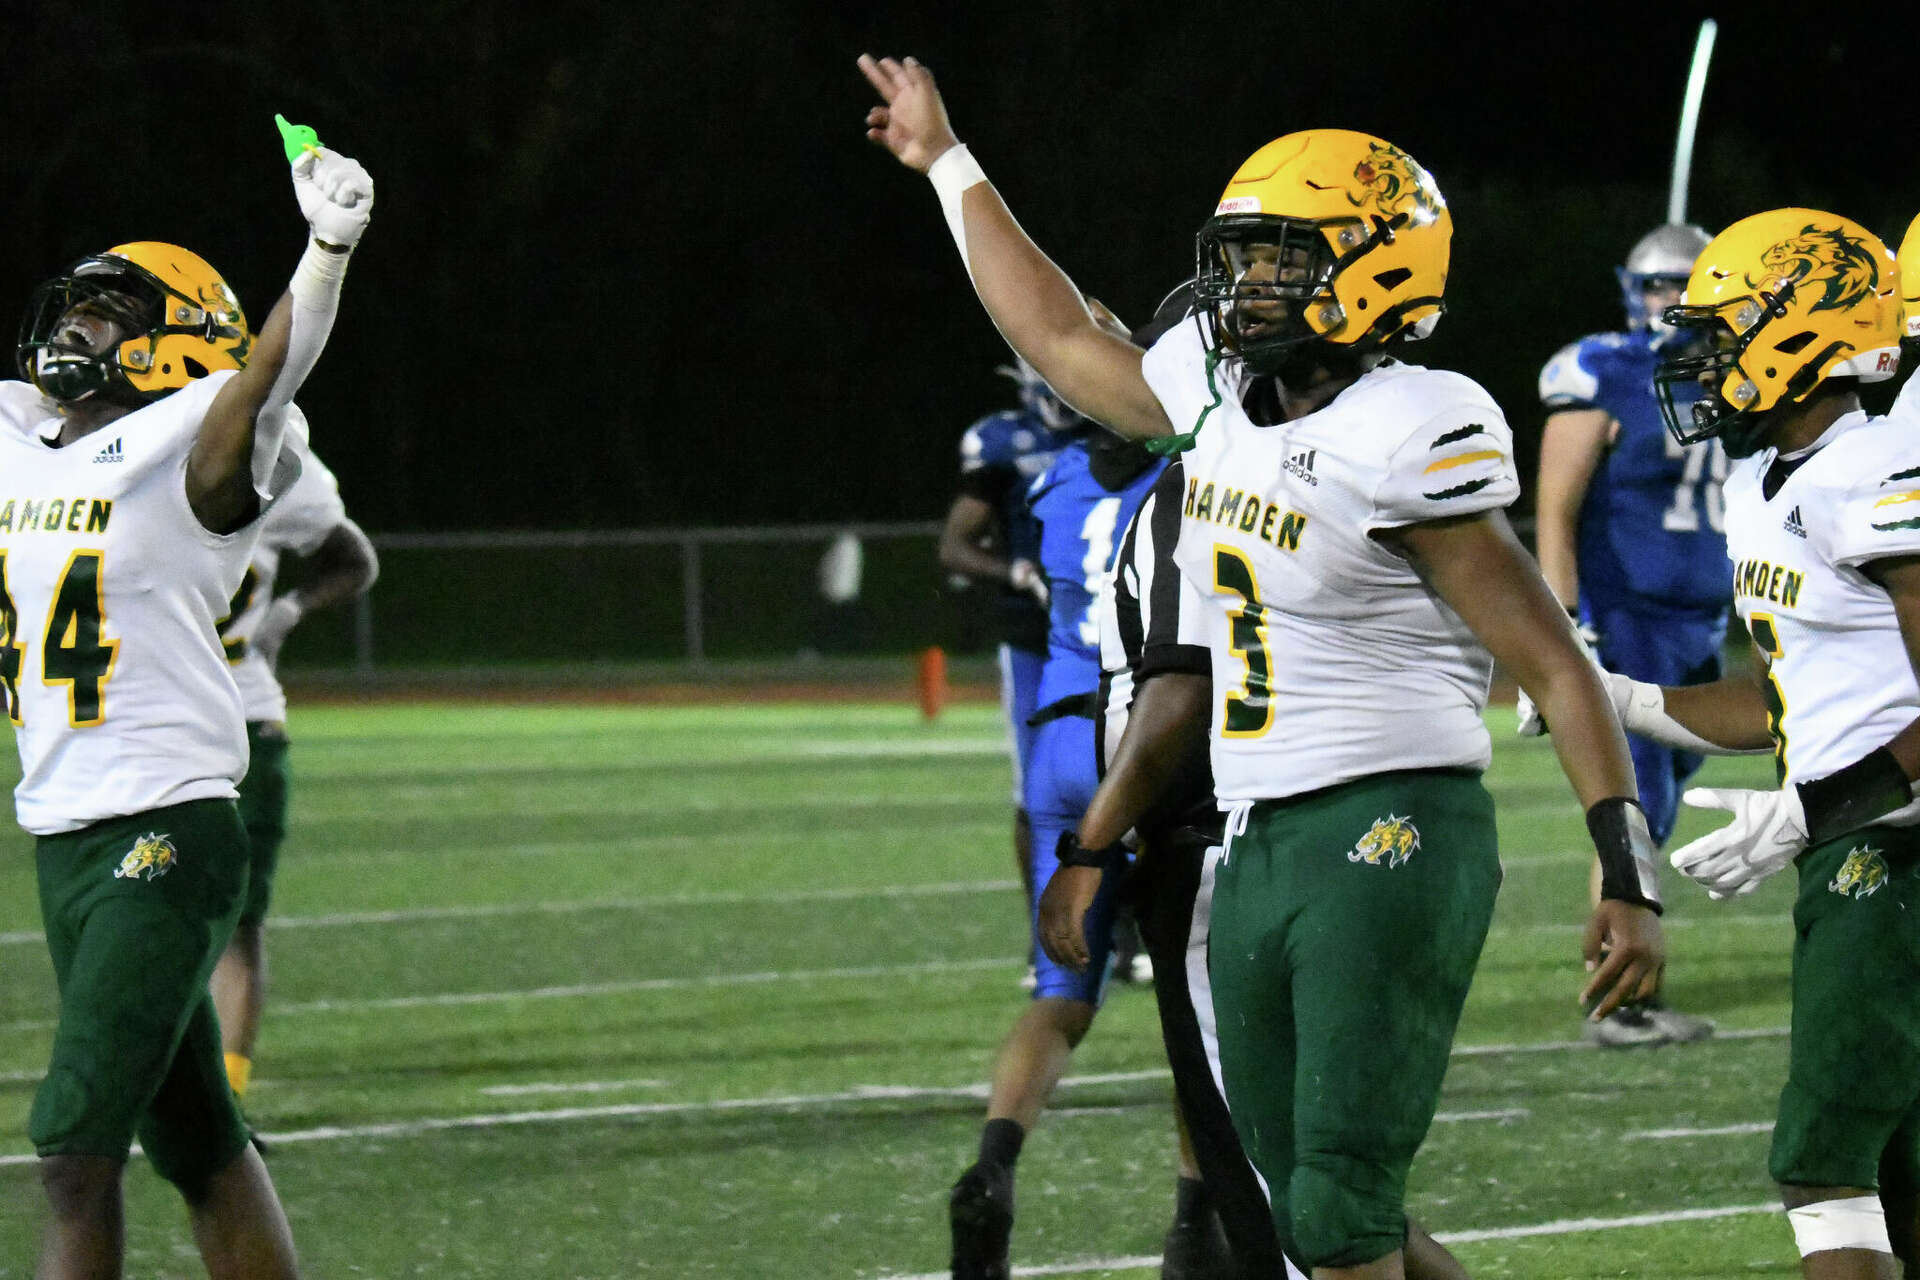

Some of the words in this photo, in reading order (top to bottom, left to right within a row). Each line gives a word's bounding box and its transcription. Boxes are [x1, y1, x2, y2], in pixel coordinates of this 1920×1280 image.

[1282, 459, 1319, 487] adidas
[1184, 476, 1308, 552] HAMDEN
[1213, 542, 1276, 739] 3
